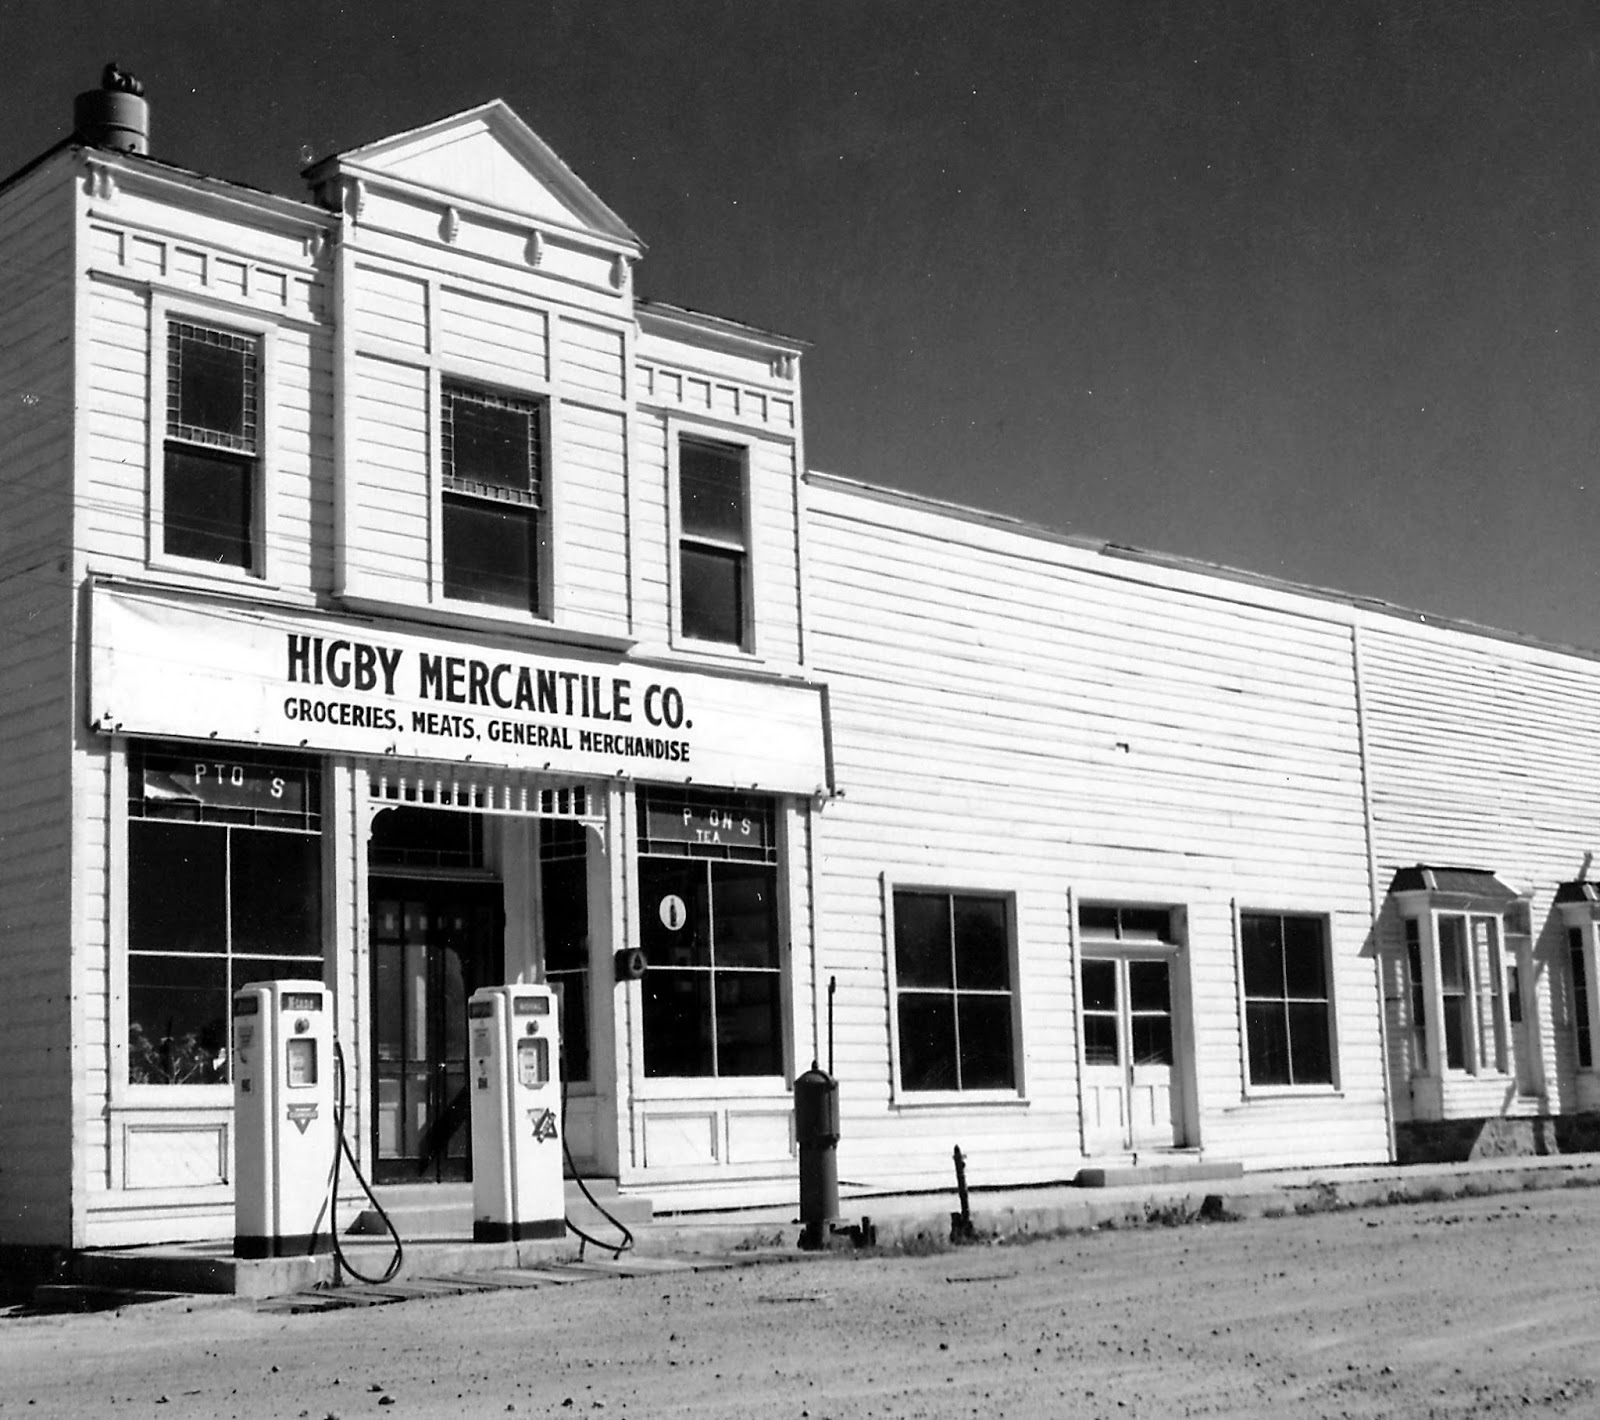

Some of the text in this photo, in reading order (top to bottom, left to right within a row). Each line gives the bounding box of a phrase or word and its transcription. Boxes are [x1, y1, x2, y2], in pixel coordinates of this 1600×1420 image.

[287, 633, 693, 729] HIGBY MERCANTILE CO.
[411, 711, 481, 742] MEATS,
[487, 720, 573, 750] GENERAL
[579, 729, 690, 763] MERCHANDISE
[696, 829, 722, 844] TEA
